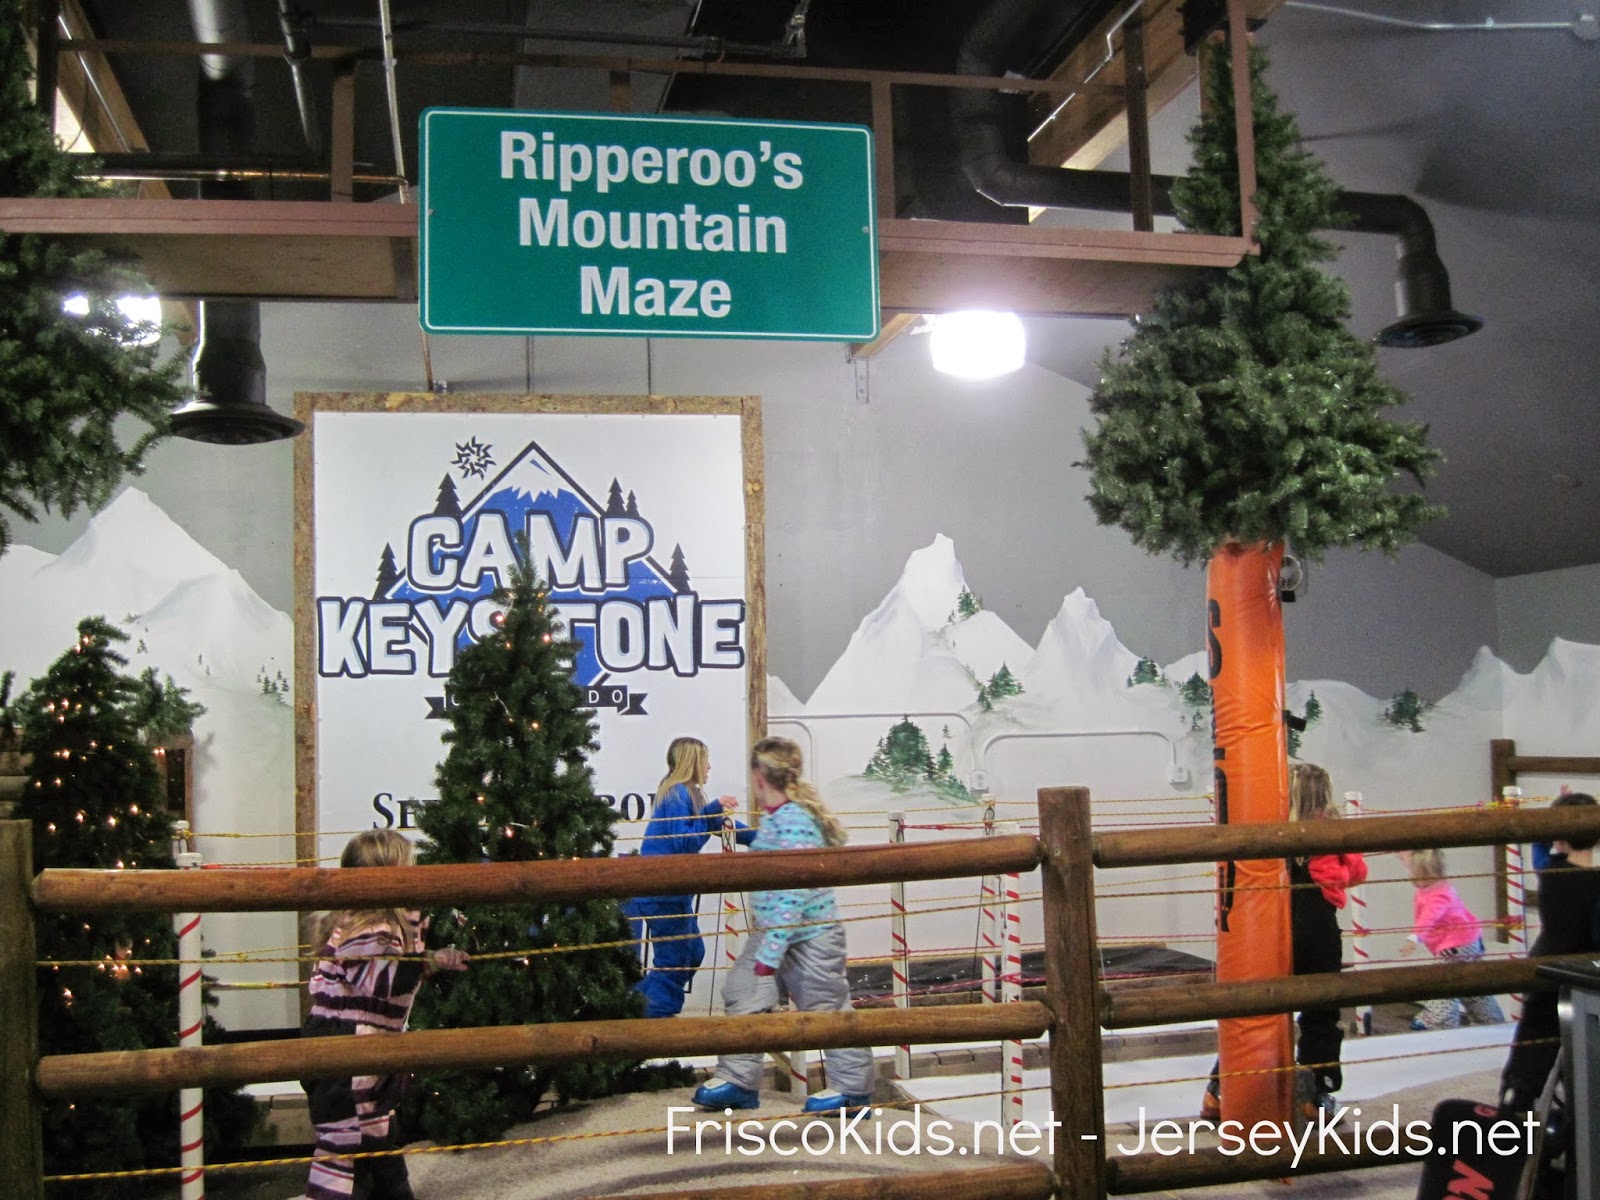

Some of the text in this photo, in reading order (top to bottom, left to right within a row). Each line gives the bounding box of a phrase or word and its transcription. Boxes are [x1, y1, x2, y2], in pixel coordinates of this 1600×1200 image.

[501, 130, 803, 193] Ripperoo's
[519, 198, 787, 253] Mountain
[580, 266, 732, 318] Maze
[407, 510, 654, 592] CAMP
